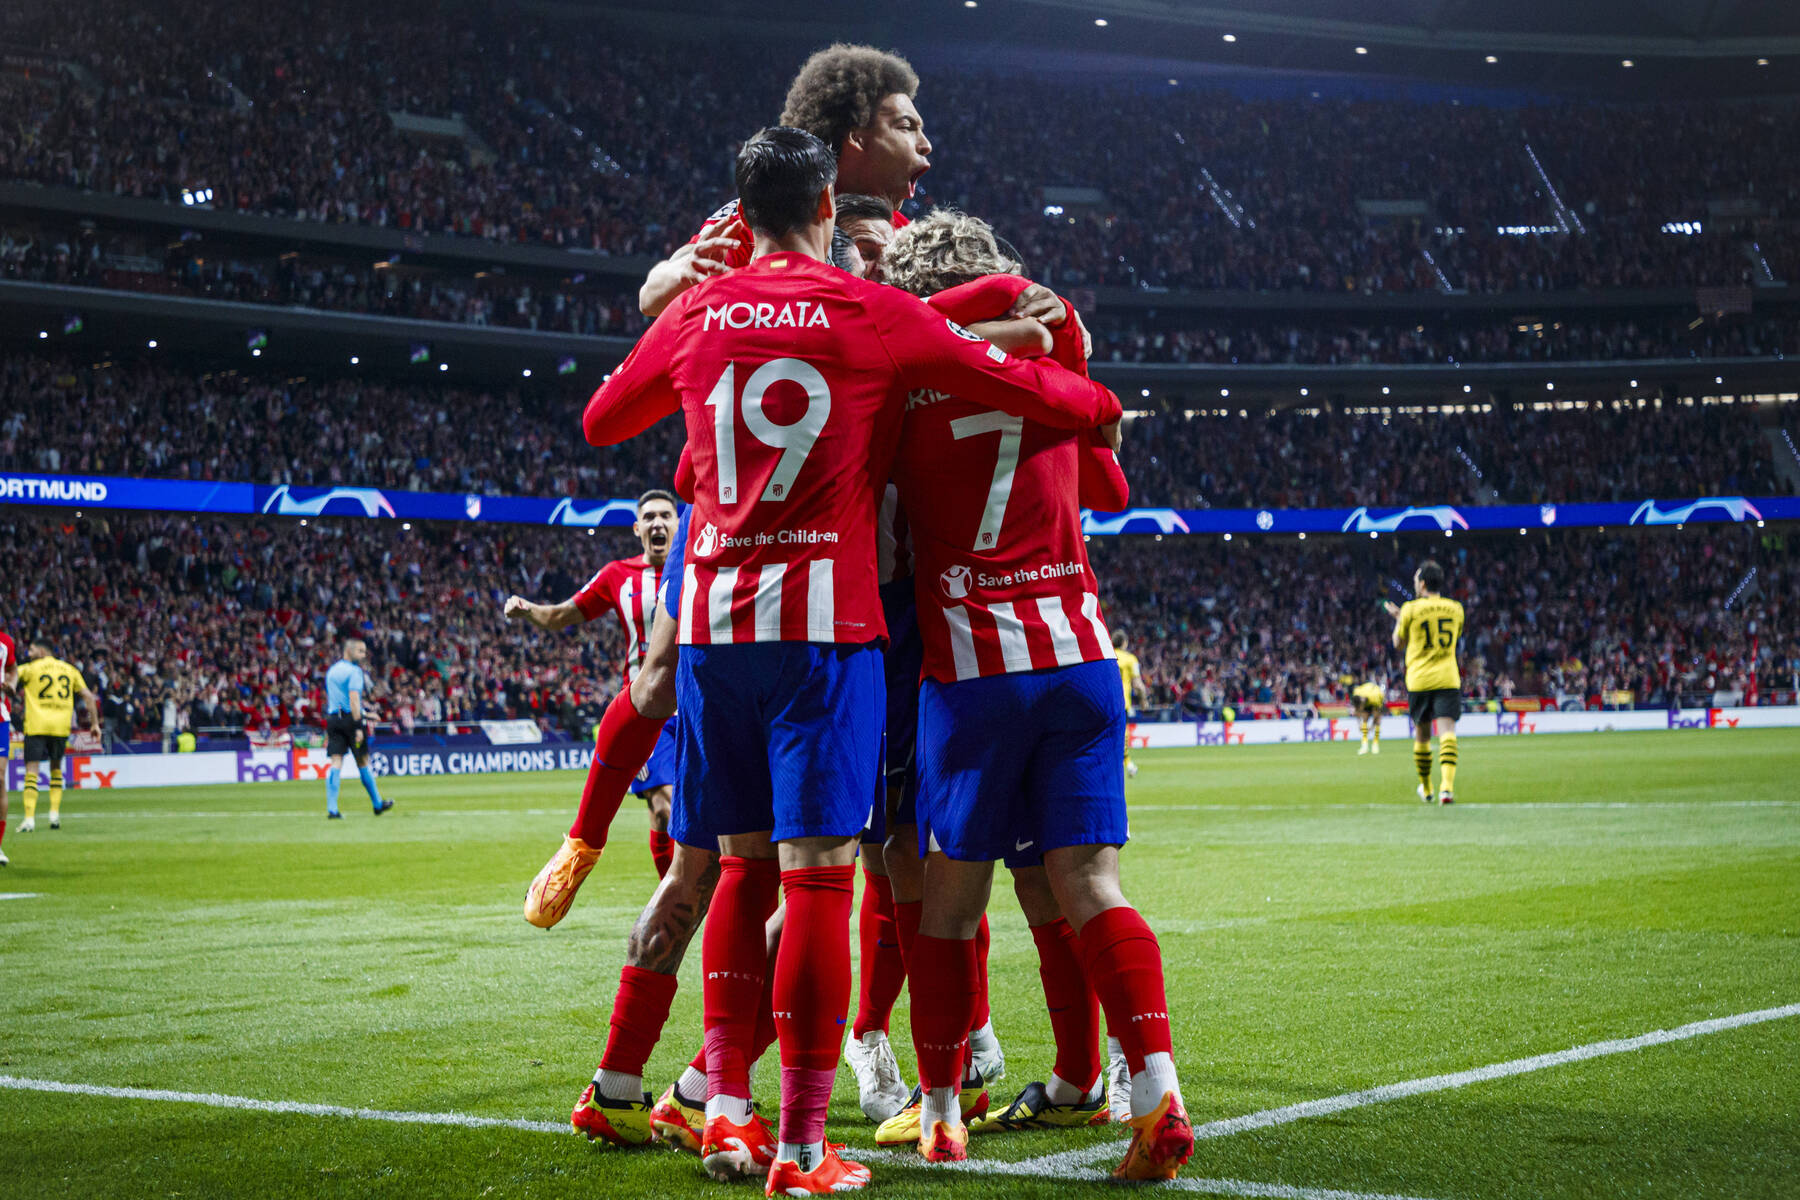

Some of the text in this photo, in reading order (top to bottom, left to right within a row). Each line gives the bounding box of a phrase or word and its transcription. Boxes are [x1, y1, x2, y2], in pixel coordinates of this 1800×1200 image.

[703, 302, 830, 331] MORATA
[704, 358, 831, 504] 19
[950, 410, 1023, 551] 7
[720, 529, 839, 548] Save the Children
[977, 573, 1012, 587] Save
[1014, 569, 1039, 583] the
[1420, 618, 1453, 650] 15
[38, 674, 70, 699] 23
[237, 749, 331, 782] FedEx
[393, 754, 444, 776] UEFA
[448, 750, 555, 775] CHAMPIONS
[1132, 1012, 1169, 1022] ATLE
